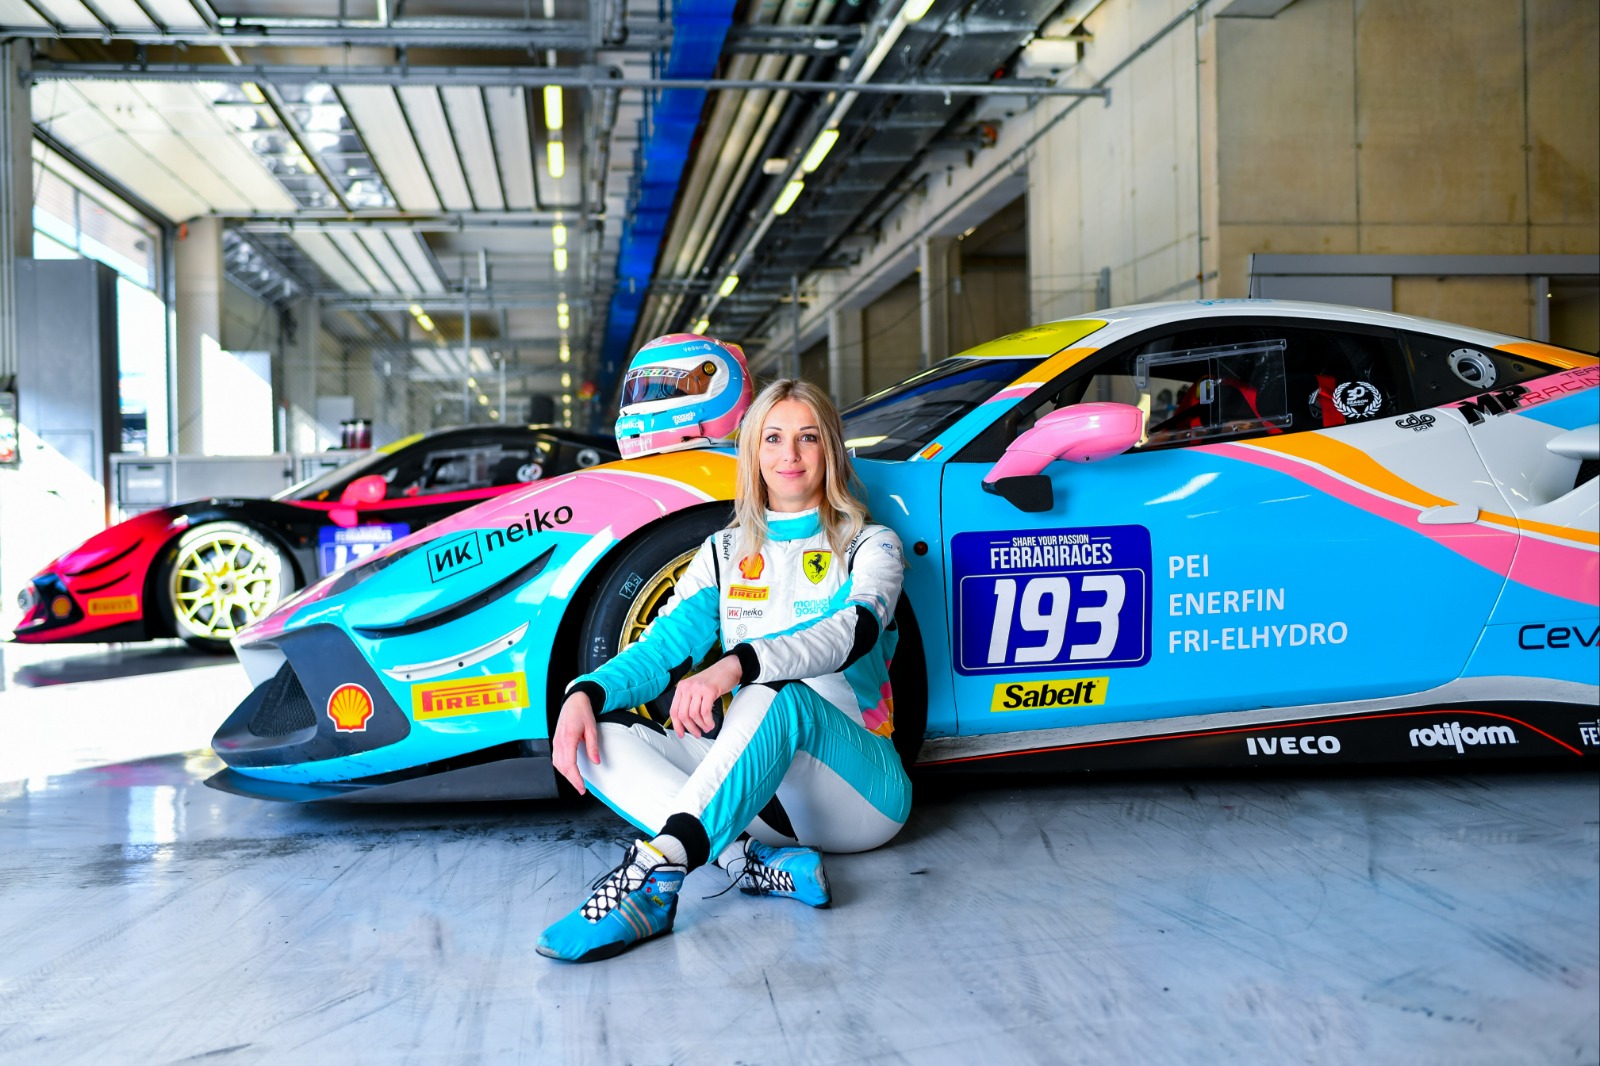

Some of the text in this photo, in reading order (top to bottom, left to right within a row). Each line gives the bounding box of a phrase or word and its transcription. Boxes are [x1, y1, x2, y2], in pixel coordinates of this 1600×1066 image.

[1456, 385, 1529, 426] MP
[485, 505, 573, 552] neiko
[1012, 534, 1089, 547] SHARE YOUR PASSION
[990, 543, 1113, 569] FERRARIRACES
[1168, 554, 1209, 579] PEI
[729, 586, 767, 599] PIRELLI
[1169, 588, 1285, 616] ENERFIN
[987, 575, 1126, 664] 193
[1169, 621, 1348, 653] FRI-ELHYDRO
[422, 680, 518, 713] PIRELLI
[1002, 681, 1097, 709] Sabelt
[1246, 735, 1341, 755] IVECO
[1580, 727, 1600, 745] FE
